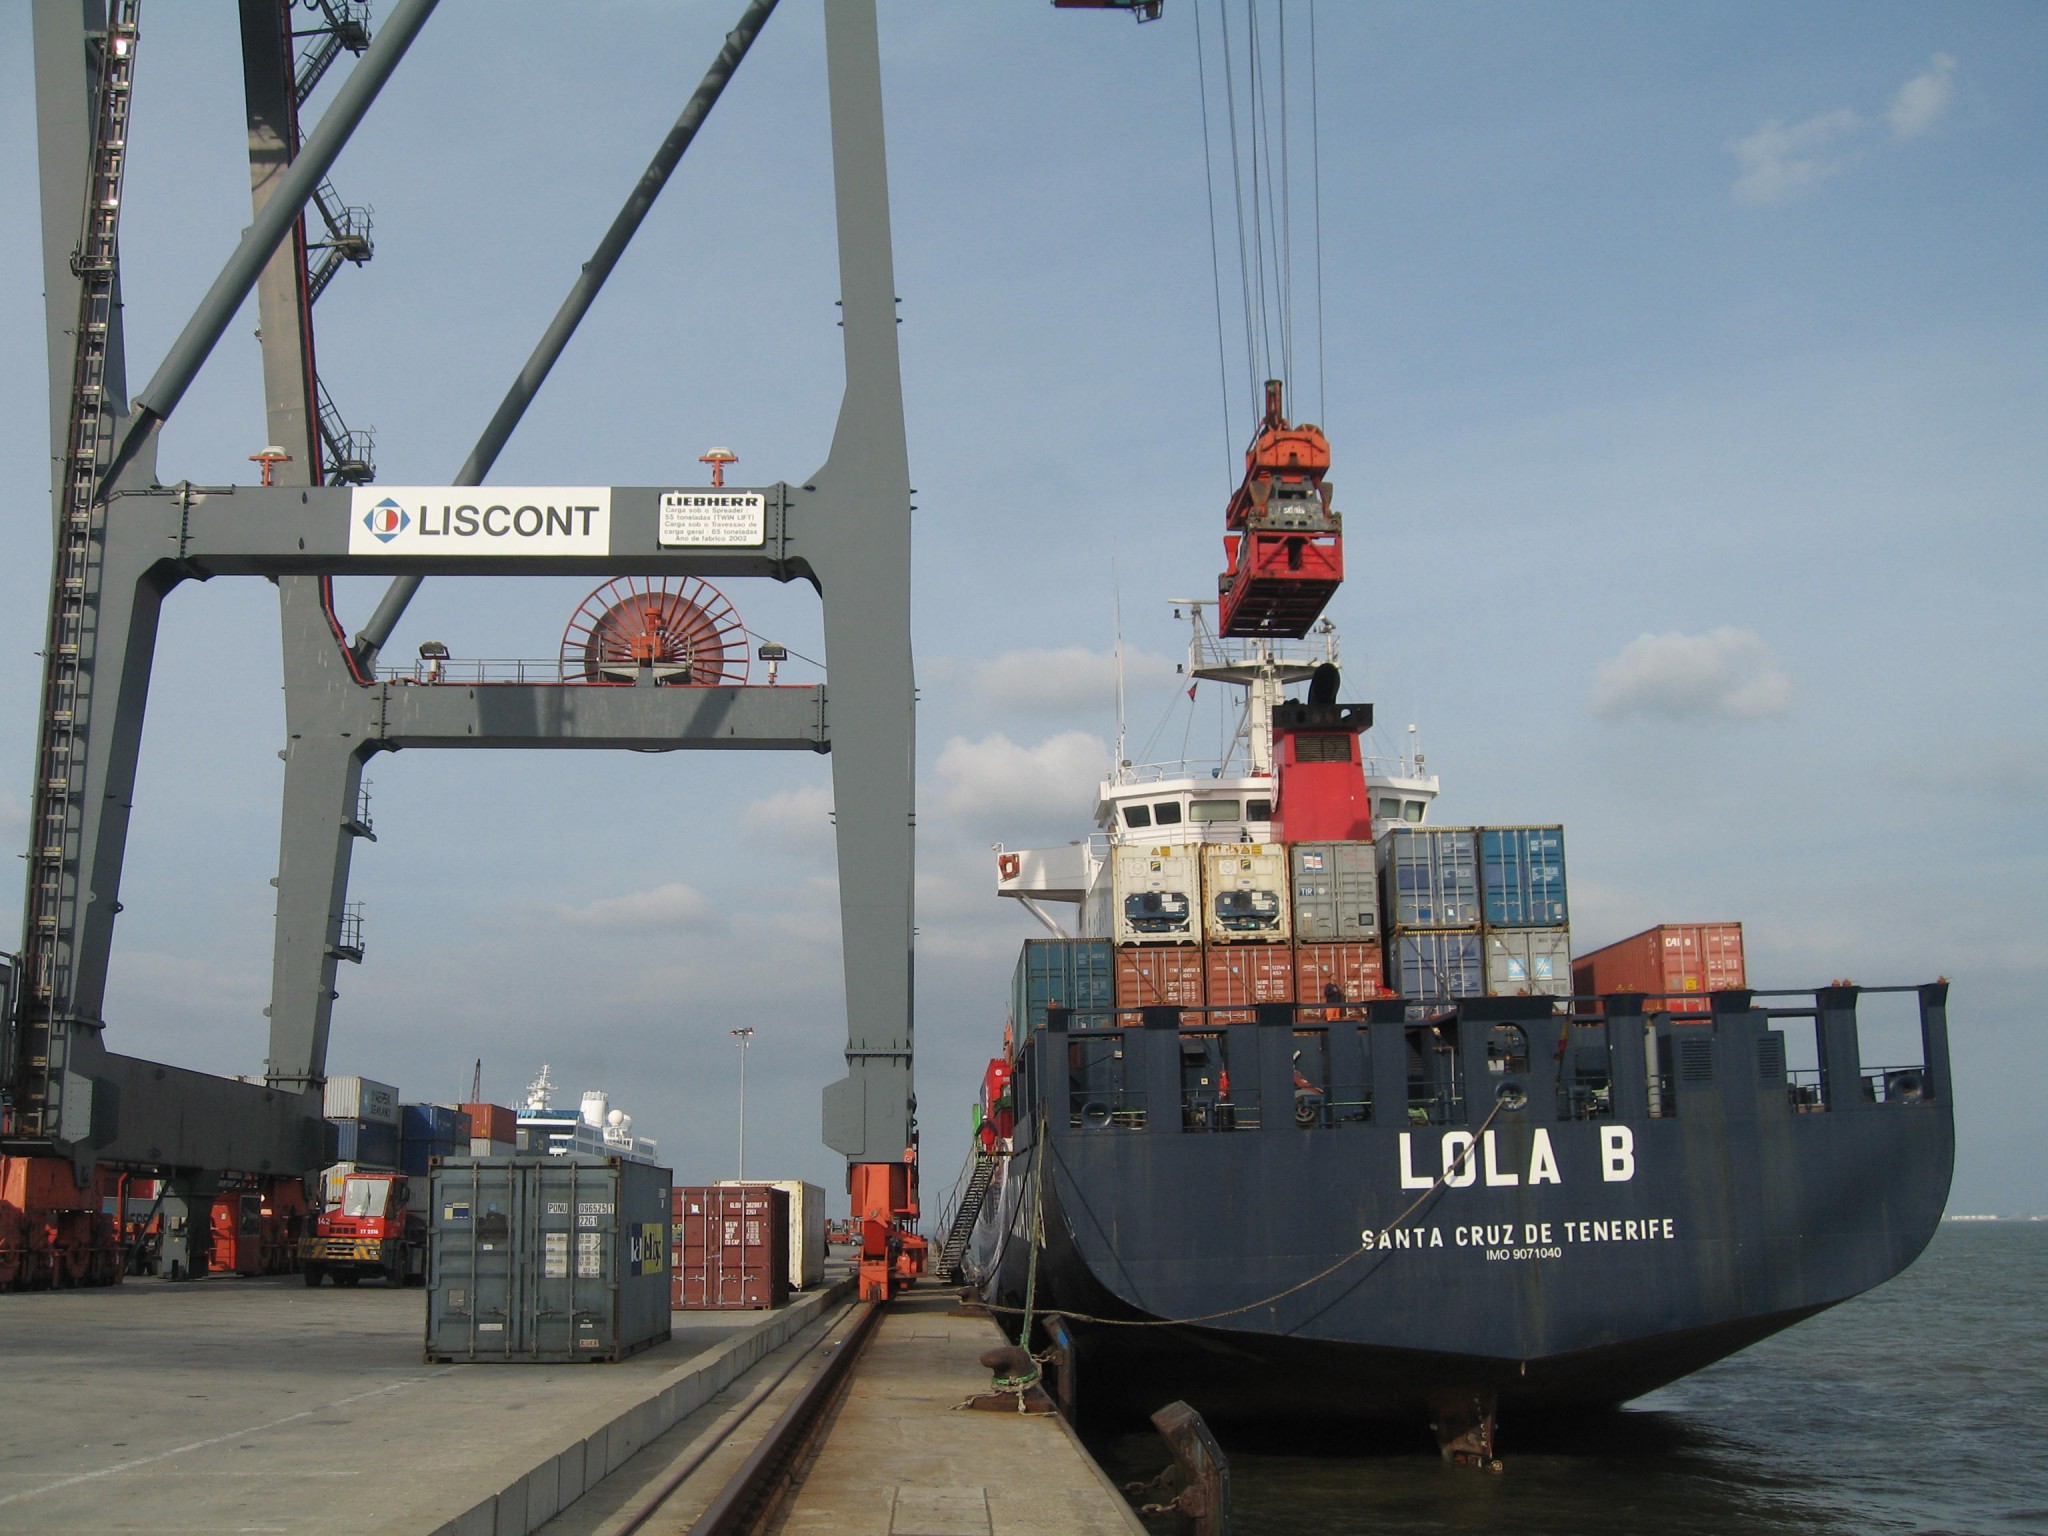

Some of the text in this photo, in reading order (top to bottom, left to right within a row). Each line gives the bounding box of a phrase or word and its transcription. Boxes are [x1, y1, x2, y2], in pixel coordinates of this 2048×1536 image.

[667, 497, 758, 506] LIEBHERR
[419, 505, 599, 537] LISCONT
[1301, 887, 1314, 896] TIR
[1399, 1125, 1635, 1189] LOLA B
[548, 1203, 567, 1213] PONU
[579, 1204, 606, 1214] 096525
[317, 1217, 330, 1225] 142
[579, 1216, 597, 1226] 22G1
[1361, 1218, 1675, 1250] SANTA CRUZ DE TENERIFE
[1486, 1247, 1562, 1260] IMO 9071040
